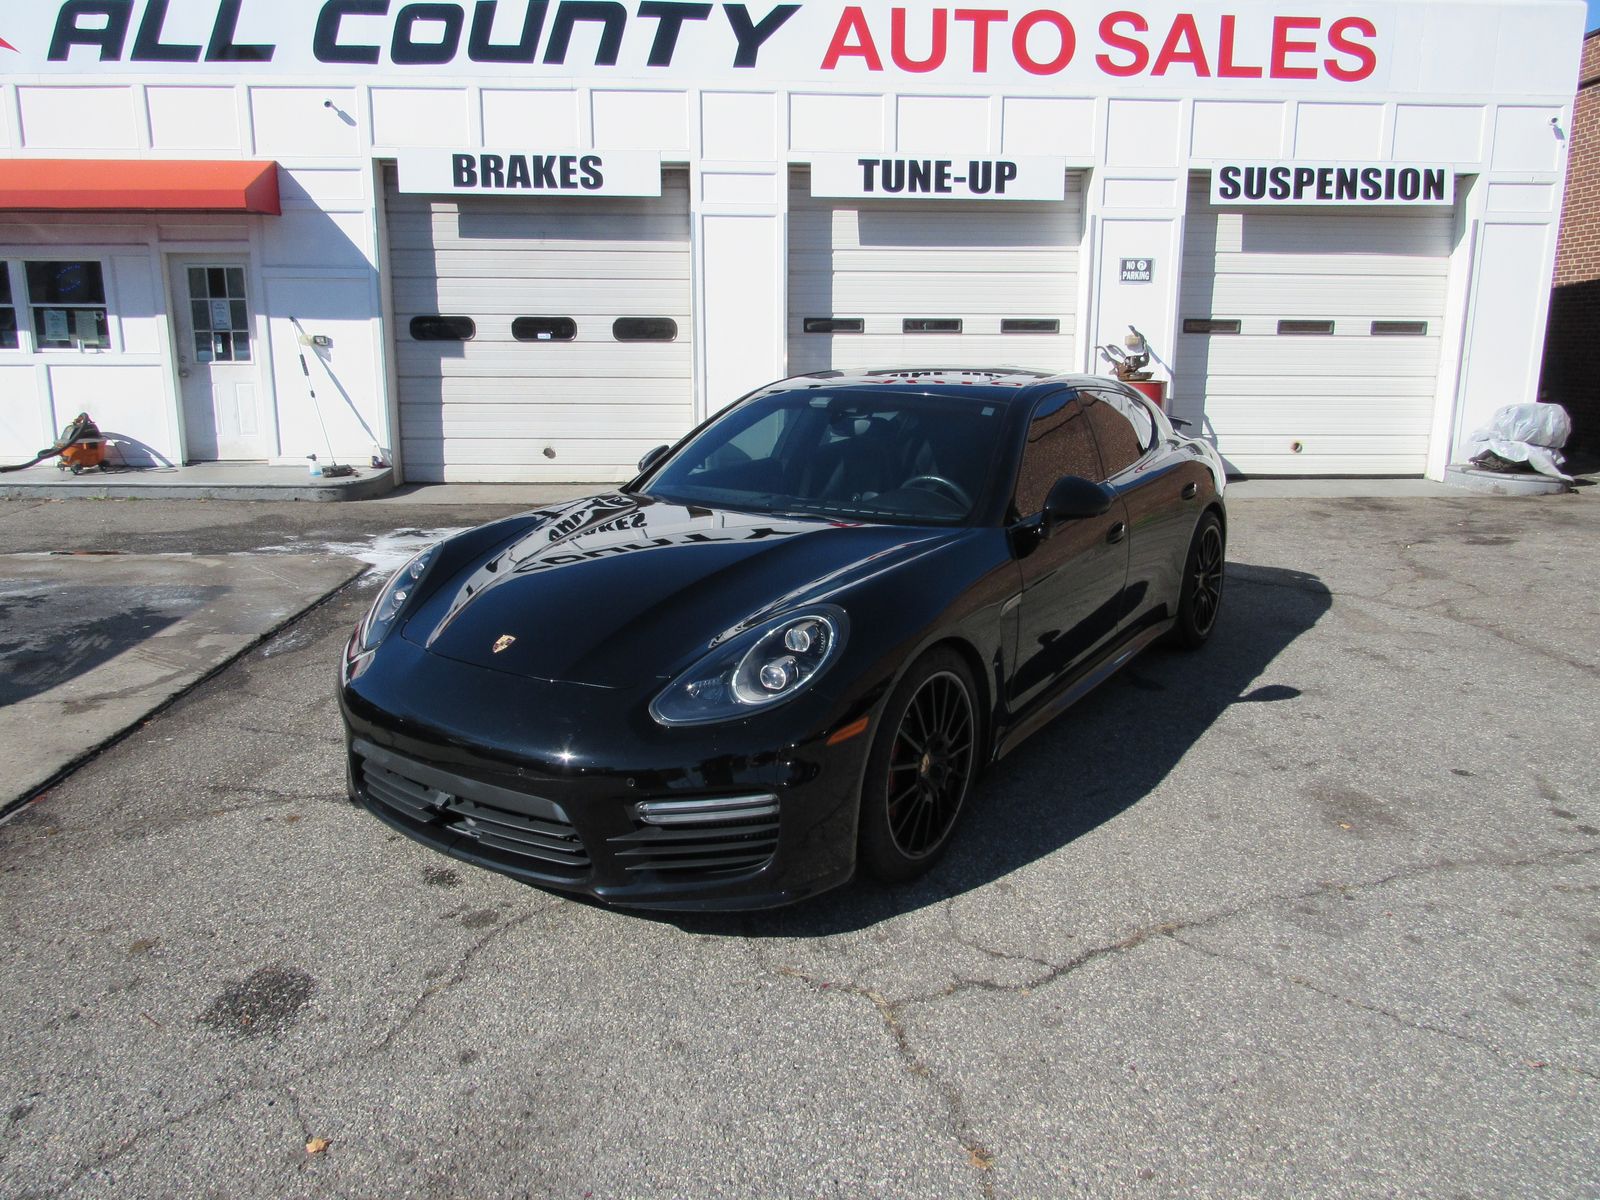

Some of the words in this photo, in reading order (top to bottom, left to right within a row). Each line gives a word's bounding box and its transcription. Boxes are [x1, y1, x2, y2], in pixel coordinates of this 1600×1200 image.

[47, 0, 276, 62] ALL
[312, 0, 803, 68] COUNTY
[820, 6, 1076, 75] AUTO
[1095, 10, 1377, 82] SALES
[452, 153, 604, 190] BRAKES
[857, 158, 1018, 194] TUNE-UP
[1219, 166, 1445, 201] SUSPENSION
[1122, 270, 1150, 281] PARKING
[1126, 260, 1136, 270] NO
